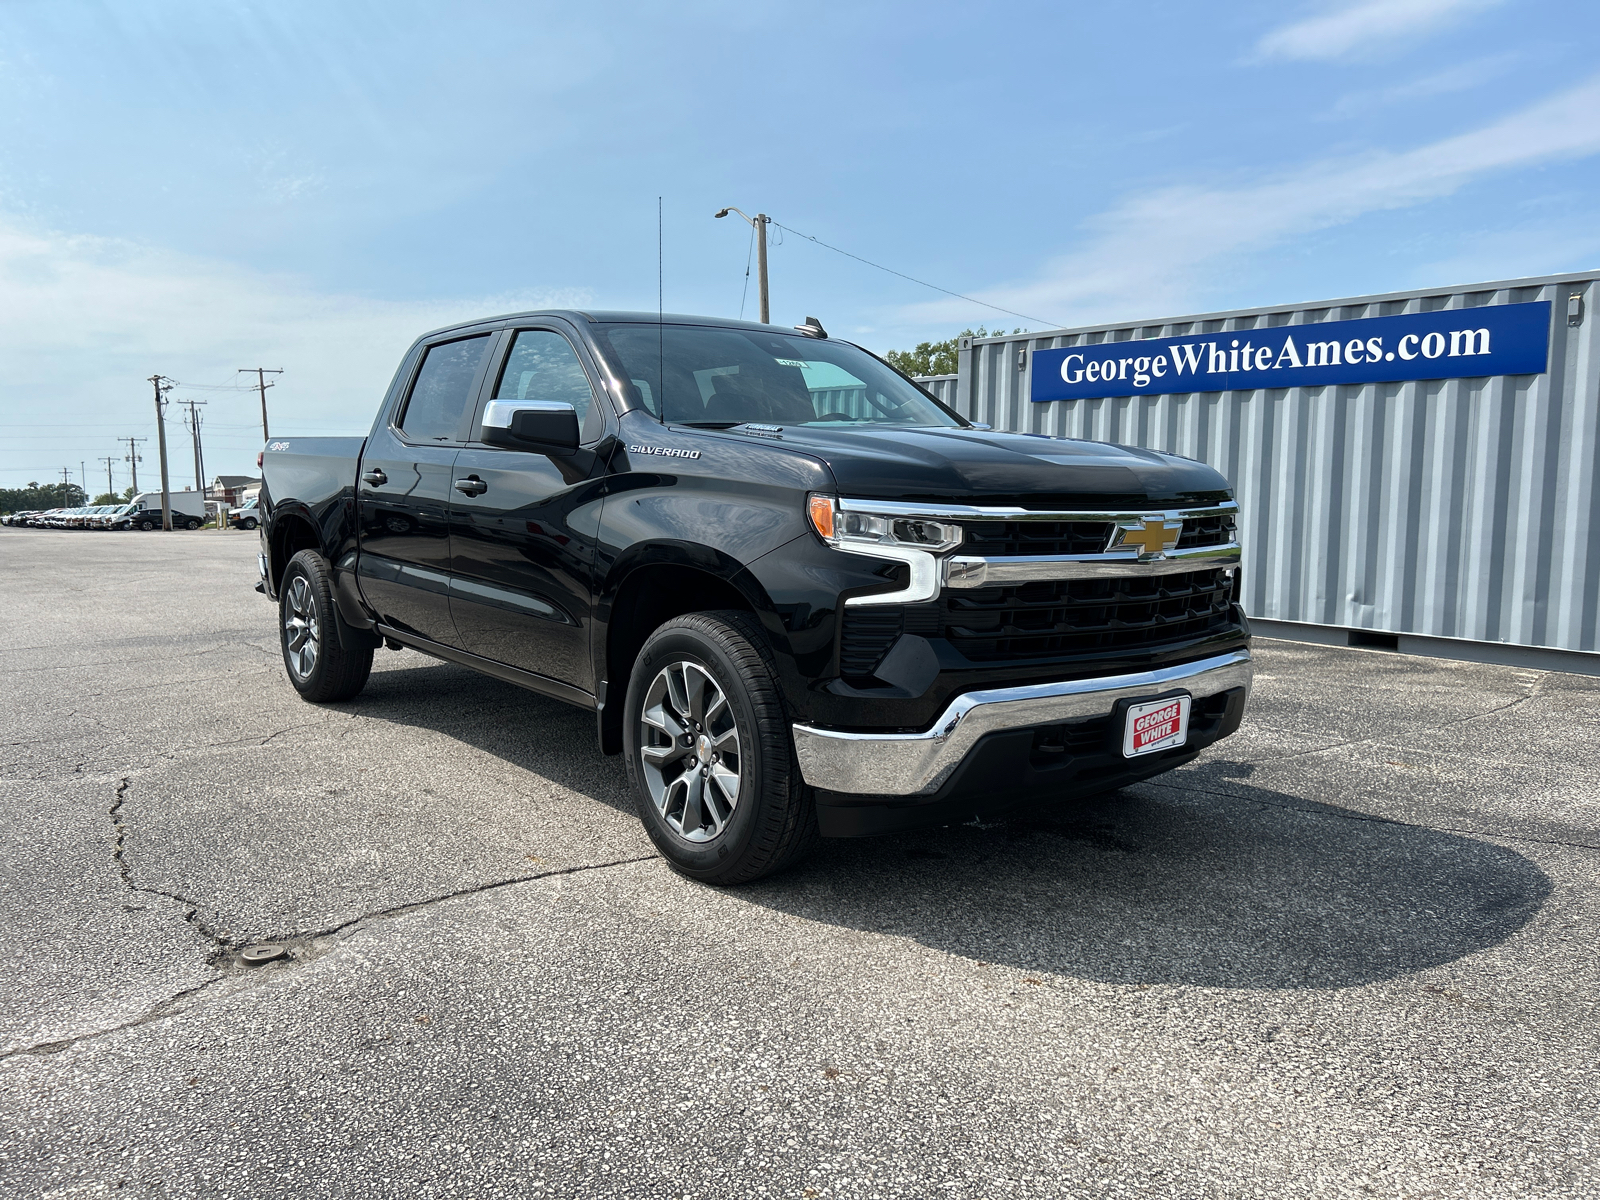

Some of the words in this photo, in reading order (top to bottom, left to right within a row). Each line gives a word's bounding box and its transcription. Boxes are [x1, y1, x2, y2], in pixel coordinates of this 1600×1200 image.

[1060, 327, 1491, 388] GeorgeWhiteAmes.com
[630, 445, 701, 460] SILVERADO
[1136, 704, 1178, 731] GEORGE
[1140, 721, 1173, 745] WHITE
